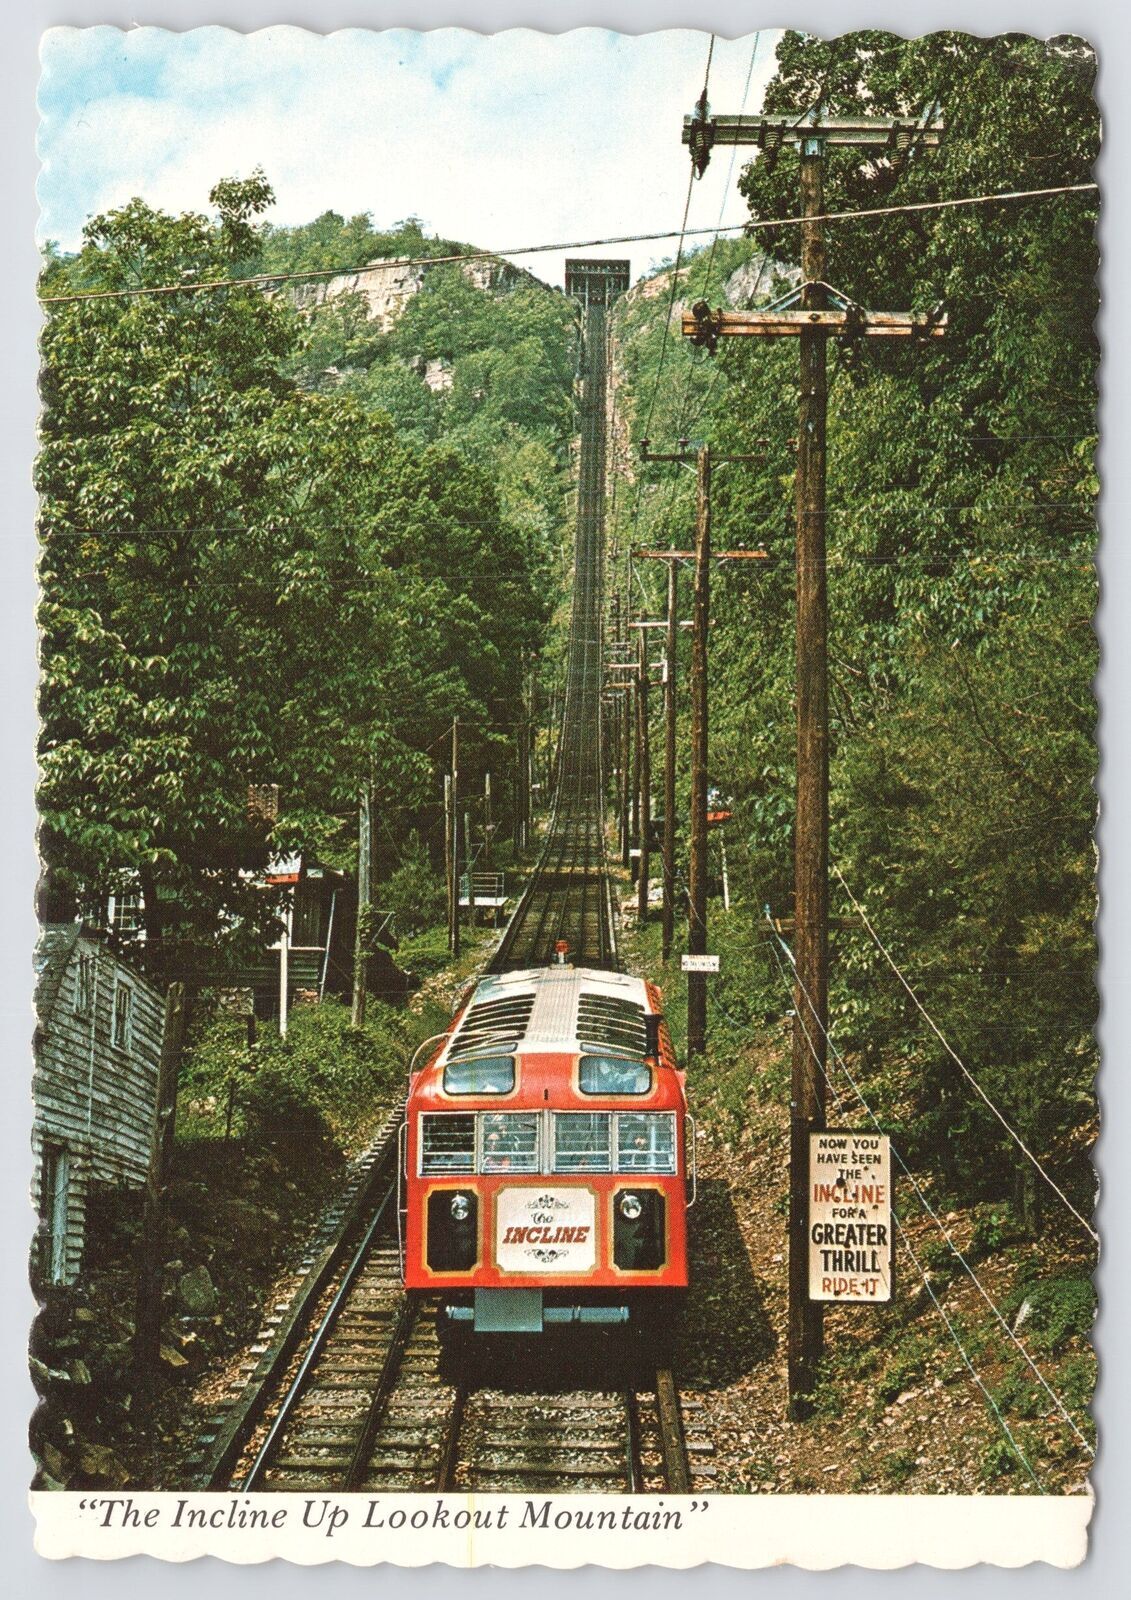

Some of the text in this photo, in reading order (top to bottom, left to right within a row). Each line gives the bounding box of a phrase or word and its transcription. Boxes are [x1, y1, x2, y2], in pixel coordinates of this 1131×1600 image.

[819, 1139, 879, 1149] NOW YOU
[817, 1154, 881, 1164] HAVE SEEN
[838, 1169, 862, 1180] THE
[813, 1184, 885, 1204] INCLINE
[832, 1208, 867, 1219] FOR A
[502, 1226, 590, 1244] INCLINE
[811, 1223, 888, 1246] GREATER
[820, 1250, 881, 1273] THRILL
[822, 1277, 858, 1295] RIDE
